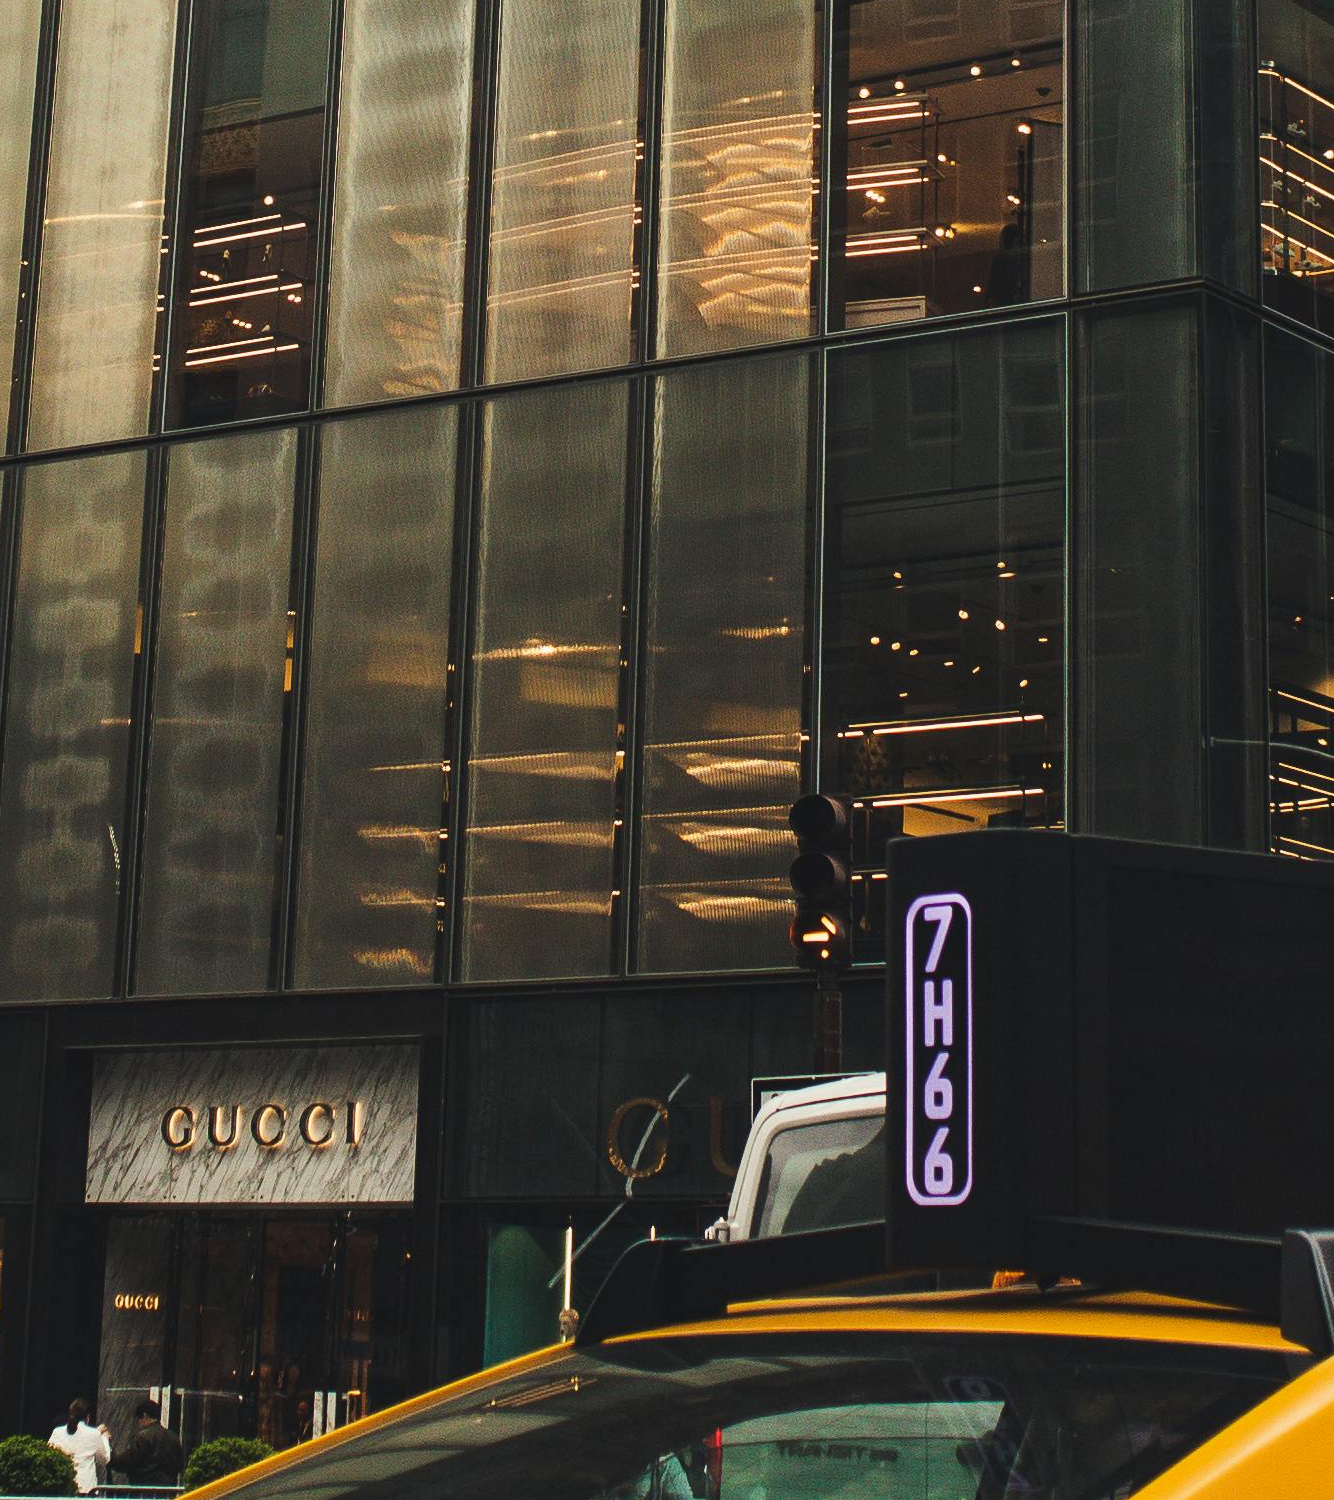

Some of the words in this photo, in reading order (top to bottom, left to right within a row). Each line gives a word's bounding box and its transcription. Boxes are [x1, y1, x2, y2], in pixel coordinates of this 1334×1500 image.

[923, 905, 954, 1195] 7H66
[161, 1101, 364, 1150] GUCCI
[114, 1293, 160, 1311] GUCCI
